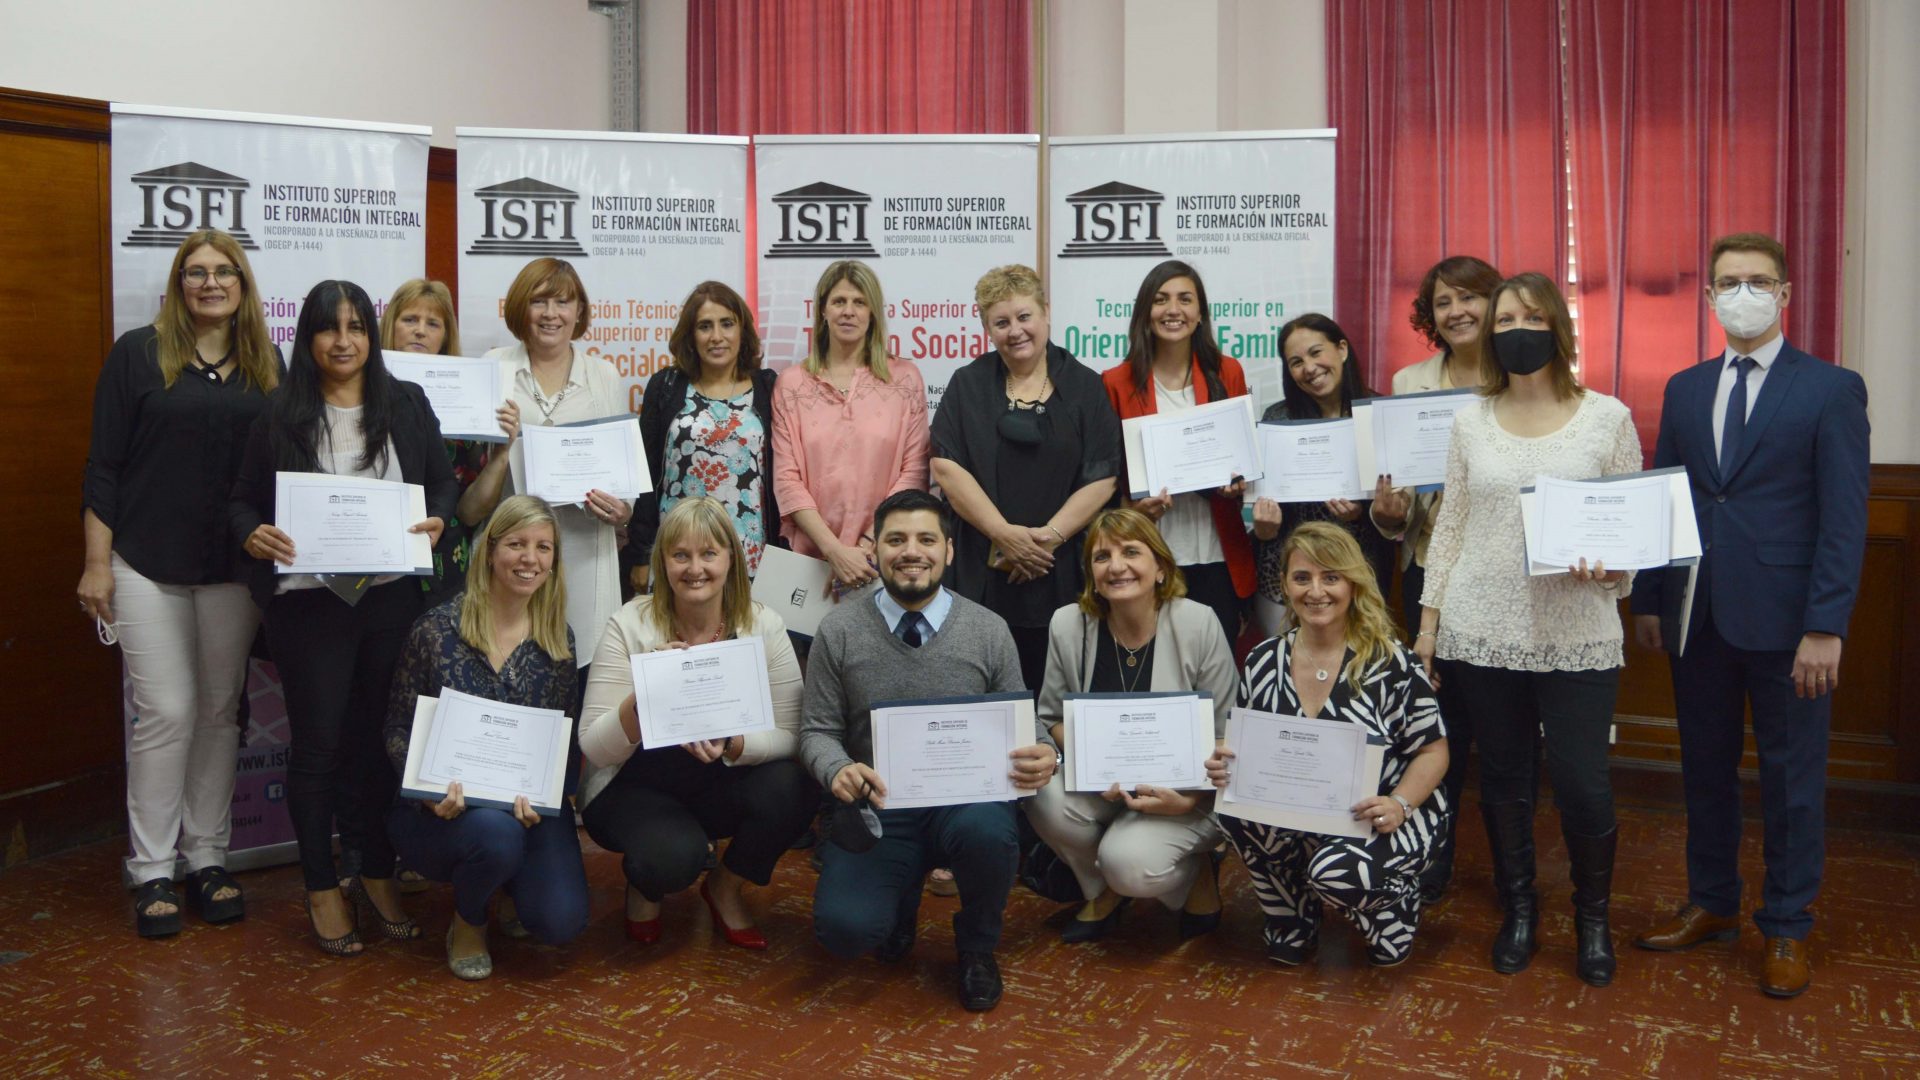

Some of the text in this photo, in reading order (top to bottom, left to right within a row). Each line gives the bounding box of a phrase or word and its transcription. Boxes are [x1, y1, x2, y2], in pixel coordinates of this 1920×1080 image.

[264, 184, 397, 206] INSTITUTO SUPERIOR
[1177, 194, 1301, 210] INSTITUTO SUPERIOR
[139, 184, 246, 231] ISFI
[593, 196, 715, 213] INSTITUTO SUPERIOR
[884, 198, 1006, 211] INSTITUTO SUPERIOR
[265, 205, 421, 227] DE FORMACIÓN INTEGRAL
[481, 199, 575, 240] ISFI
[593, 214, 741, 232] DE FORMACIÓN INTEGRAL
[778, 203, 869, 242] ISFI
[884, 214, 1032, 230] DE FORMACIÓN INTEGRAL
[1071, 202, 1162, 242] ISFI
[1177, 211, 1329, 228] DE FORMACIÓN INTEGRAL
[264, 226, 406, 241] INCORPORADO A LA ENSEÑANZA OFICIAL
[592, 234, 725, 246] INCORPORADO A LA ENSEÑANZA OFICIAL
[884, 234, 1015, 245] INCORPORADO A LA ENSEÑANZA OFICIAL
[1177, 232, 1311, 243] INCORPORADO A LA ENSEÑANZA OFICIAL
[264, 240, 323, 251] (DGEGP A-1444)
[592, 247, 646, 257] (DGEGP A-1444)
[884, 248, 937, 257] (DGEGP A-1444)
[1176, 246, 1230, 256] (DGEGP A-1444)
[903, 299, 967, 321] Superior
[1209, 298, 1260, 321] perior
[1265, 302, 1283, 317] en
[584, 322, 673, 345] Superior en
